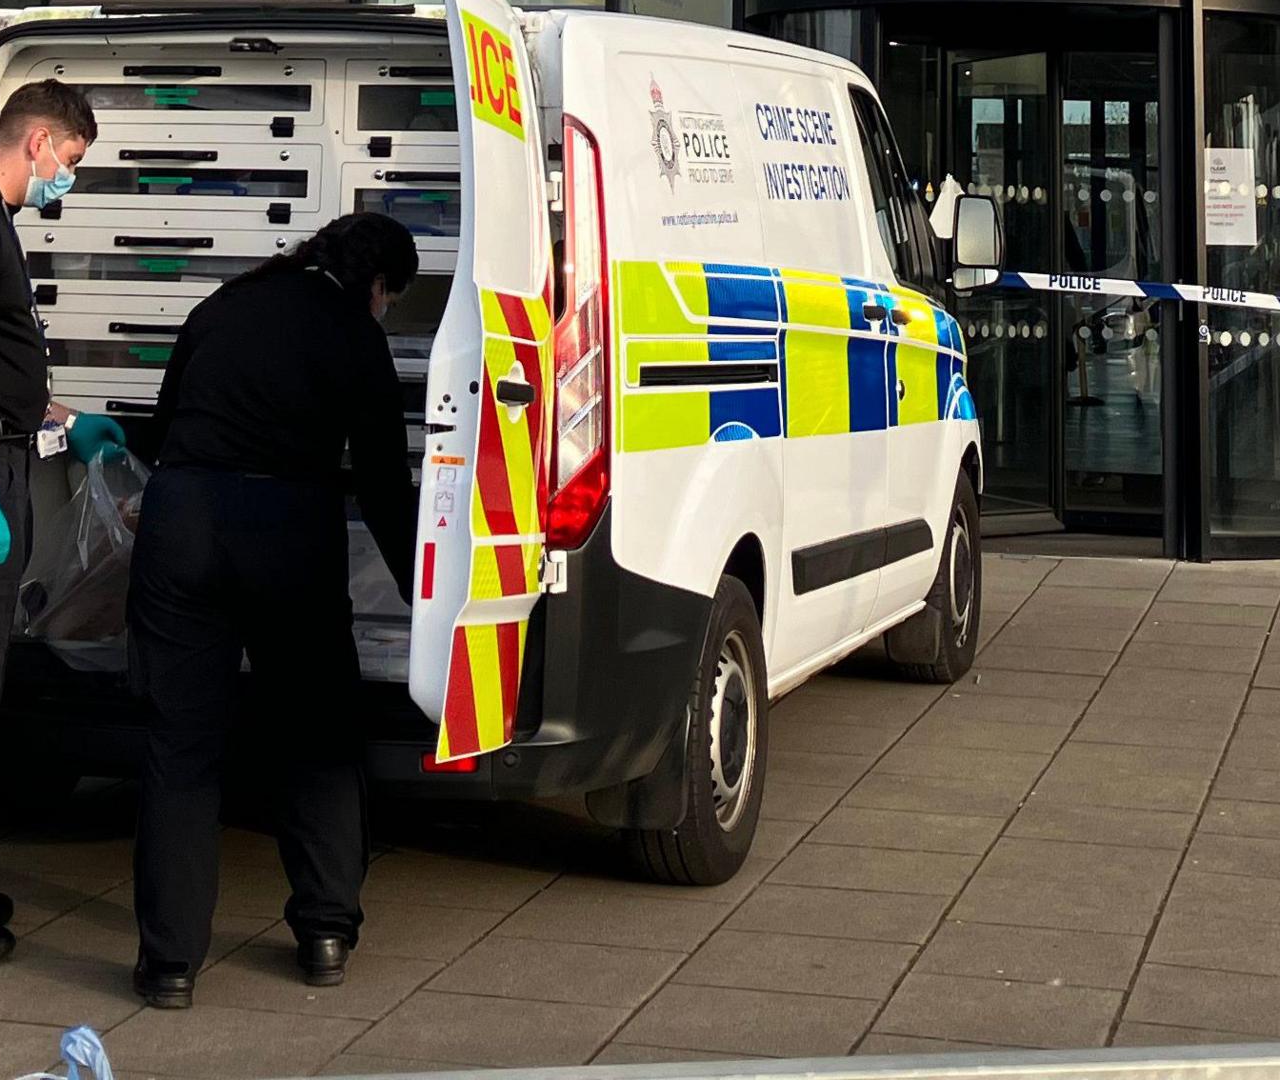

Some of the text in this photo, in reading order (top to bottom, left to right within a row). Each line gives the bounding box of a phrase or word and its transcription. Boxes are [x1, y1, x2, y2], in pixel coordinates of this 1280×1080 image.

[469, 22, 523, 128] ICE
[755, 103, 836, 145] CRIME SCENE
[683, 132, 730, 158] POLICE
[763, 162, 851, 200] INVESTIGATION
[1048, 274, 1101, 290] POLICE
[1202, 286, 1247, 303] POLICE
